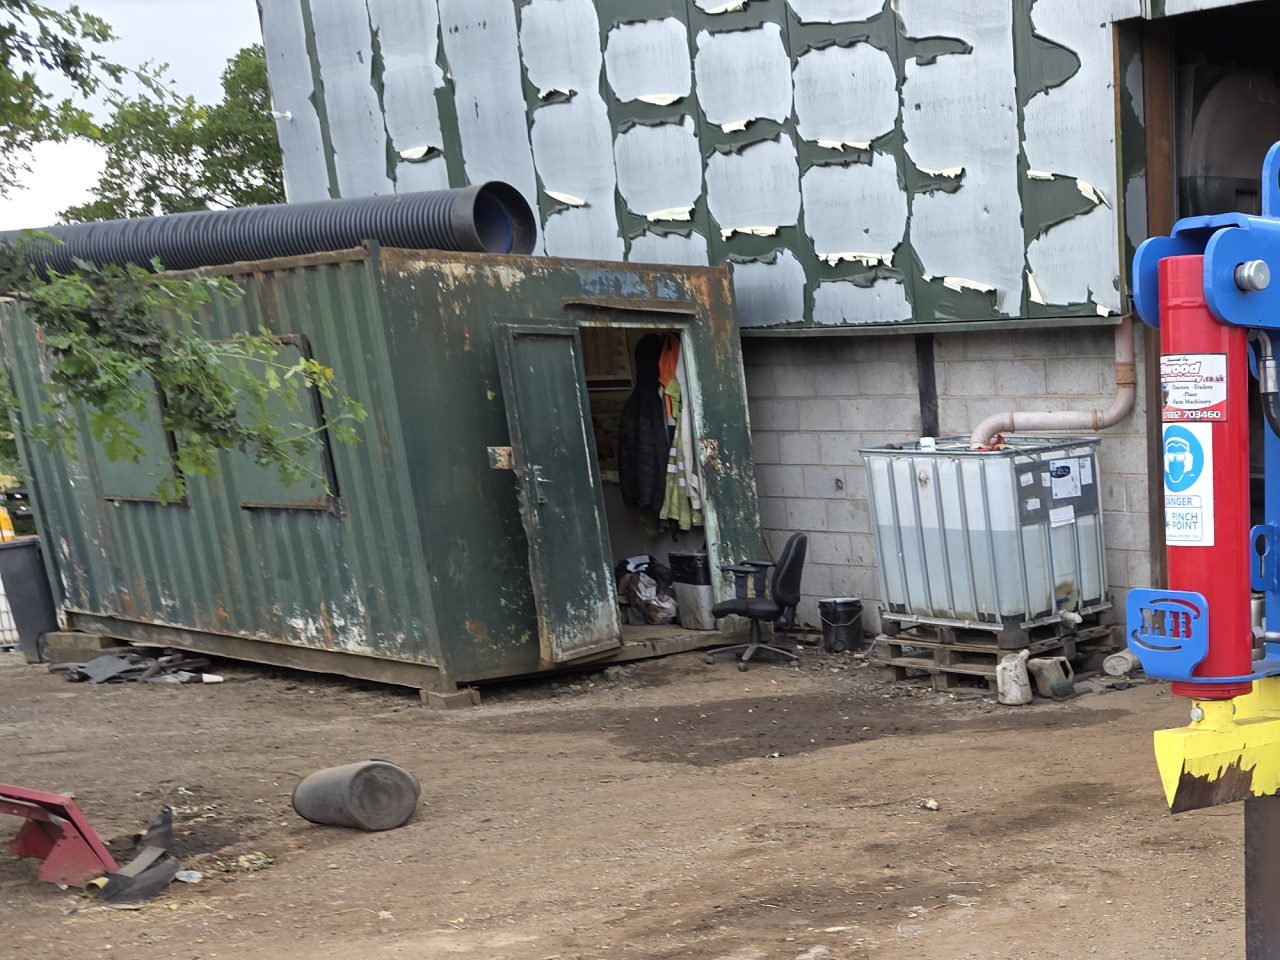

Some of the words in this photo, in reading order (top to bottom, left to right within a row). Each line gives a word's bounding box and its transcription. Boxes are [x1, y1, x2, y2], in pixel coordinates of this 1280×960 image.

[1183, 410, 1221, 418] 703460
[1172, 512, 1198, 521] PINCH
[1172, 521, 1199, 530] POINT
